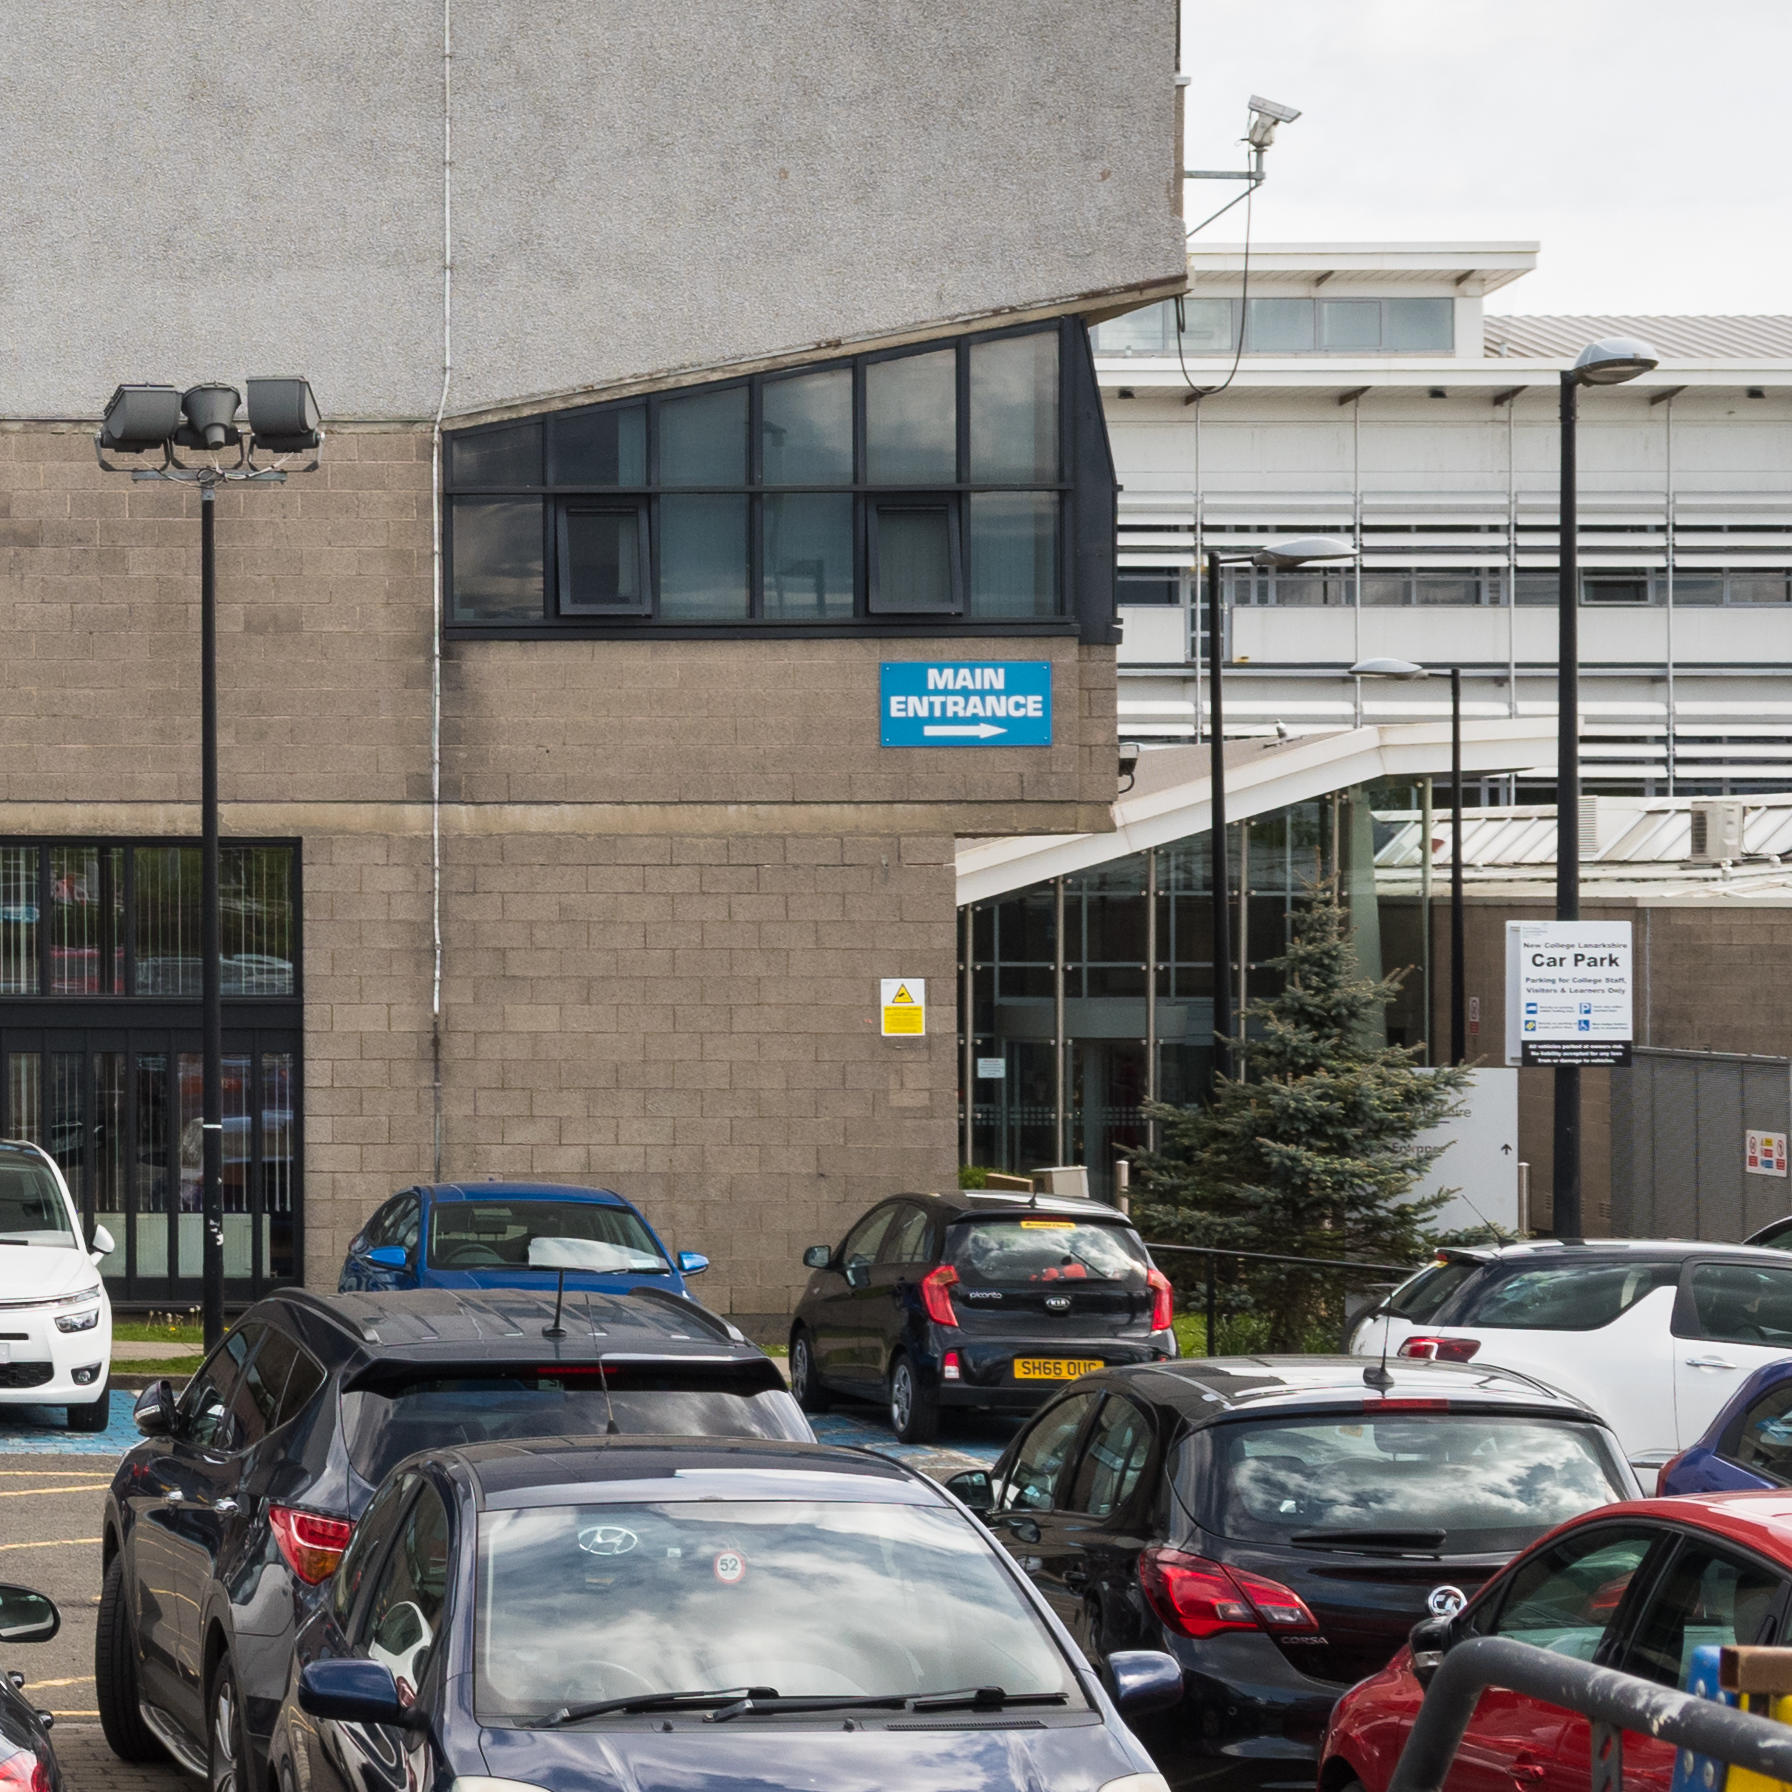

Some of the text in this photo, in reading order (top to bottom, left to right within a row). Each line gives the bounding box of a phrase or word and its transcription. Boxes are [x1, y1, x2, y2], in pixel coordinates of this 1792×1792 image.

[926, 667, 1005, 690] MAIN
[890, 695, 1043, 718] ENTRANCE
[1532, 953, 1619, 967] Car Park
[1022, 1361, 1063, 1376] SH66
[720, 1558, 738, 1571] 52
